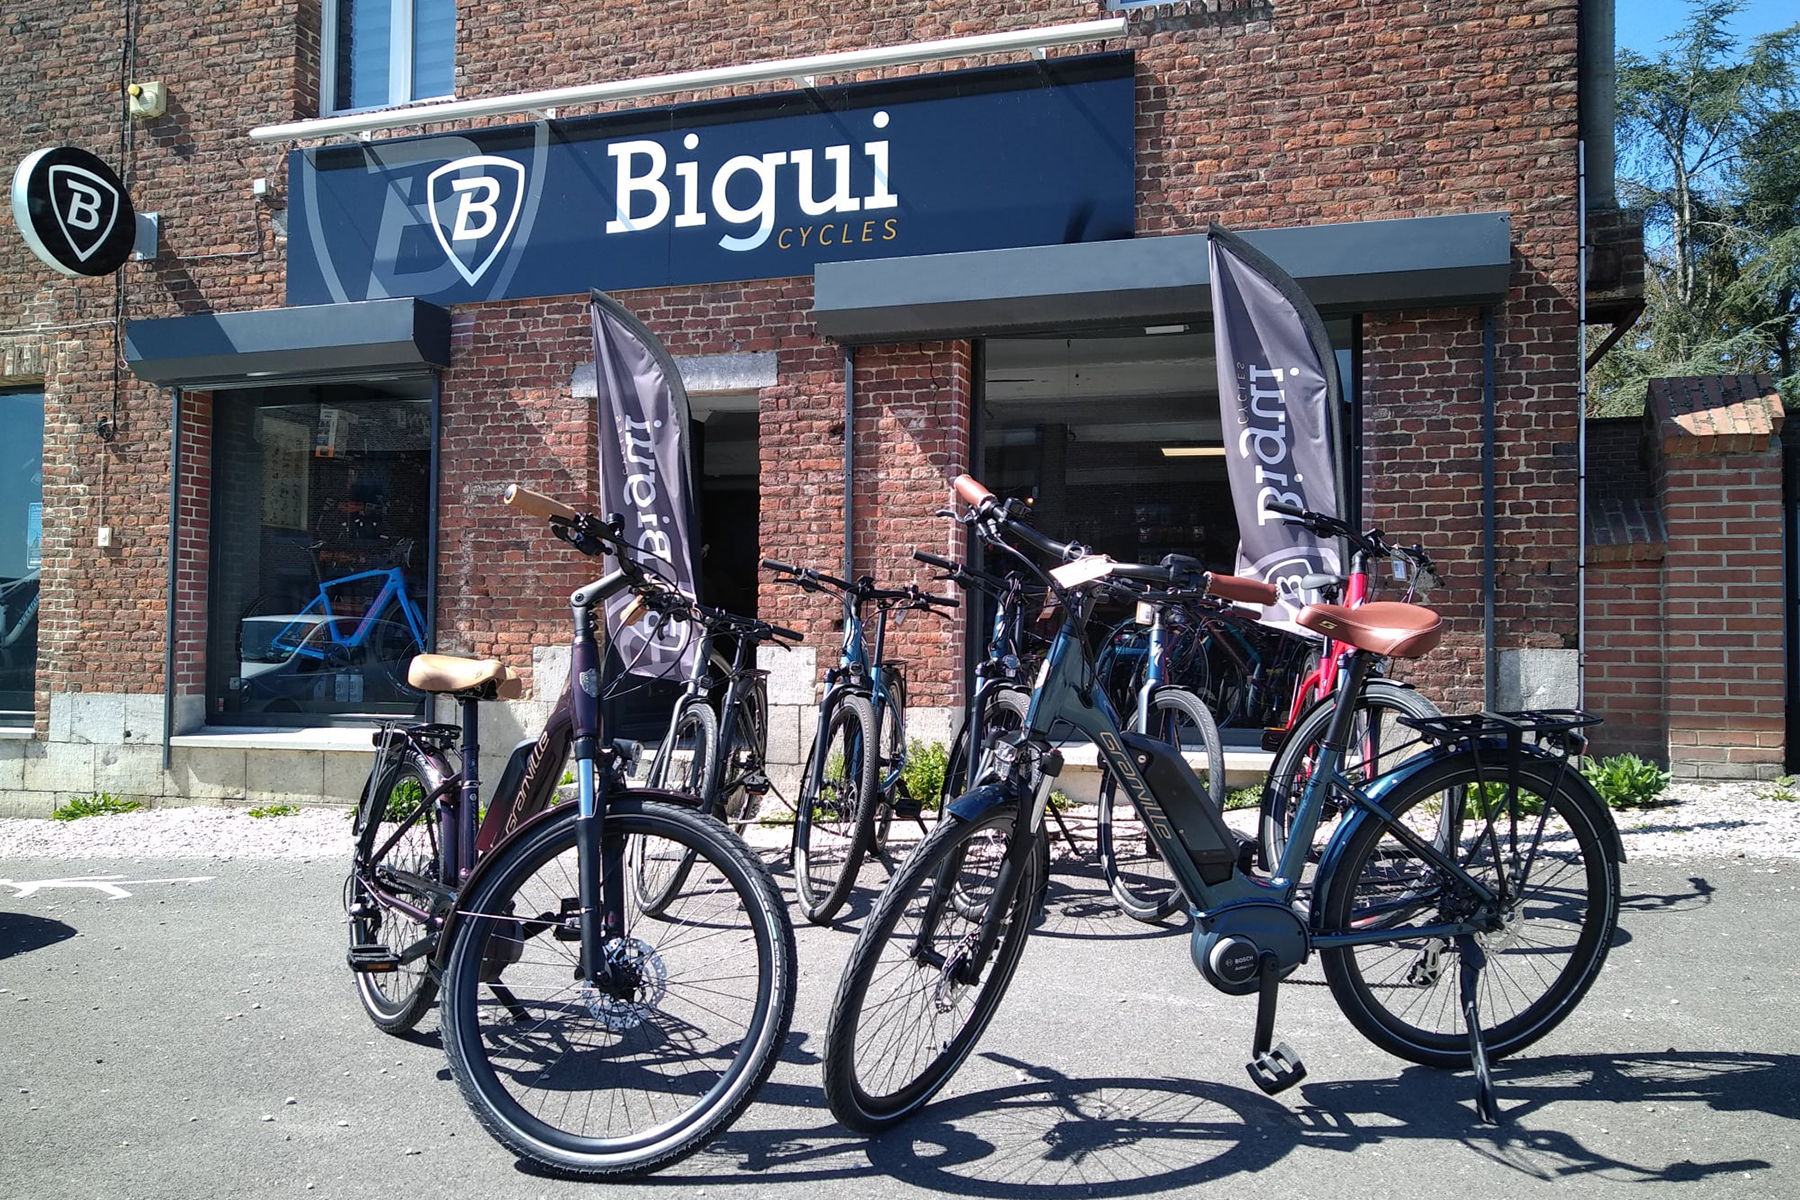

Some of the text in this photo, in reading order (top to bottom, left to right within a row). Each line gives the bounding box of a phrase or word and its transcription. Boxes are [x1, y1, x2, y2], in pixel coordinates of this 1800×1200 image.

[66, 178, 102, 231] B
[605, 110, 898, 252] Bigui
[451, 176, 500, 241] B
[777, 218, 898, 250] CYCLES
[1234, 955, 1254, 965] BOSCH
